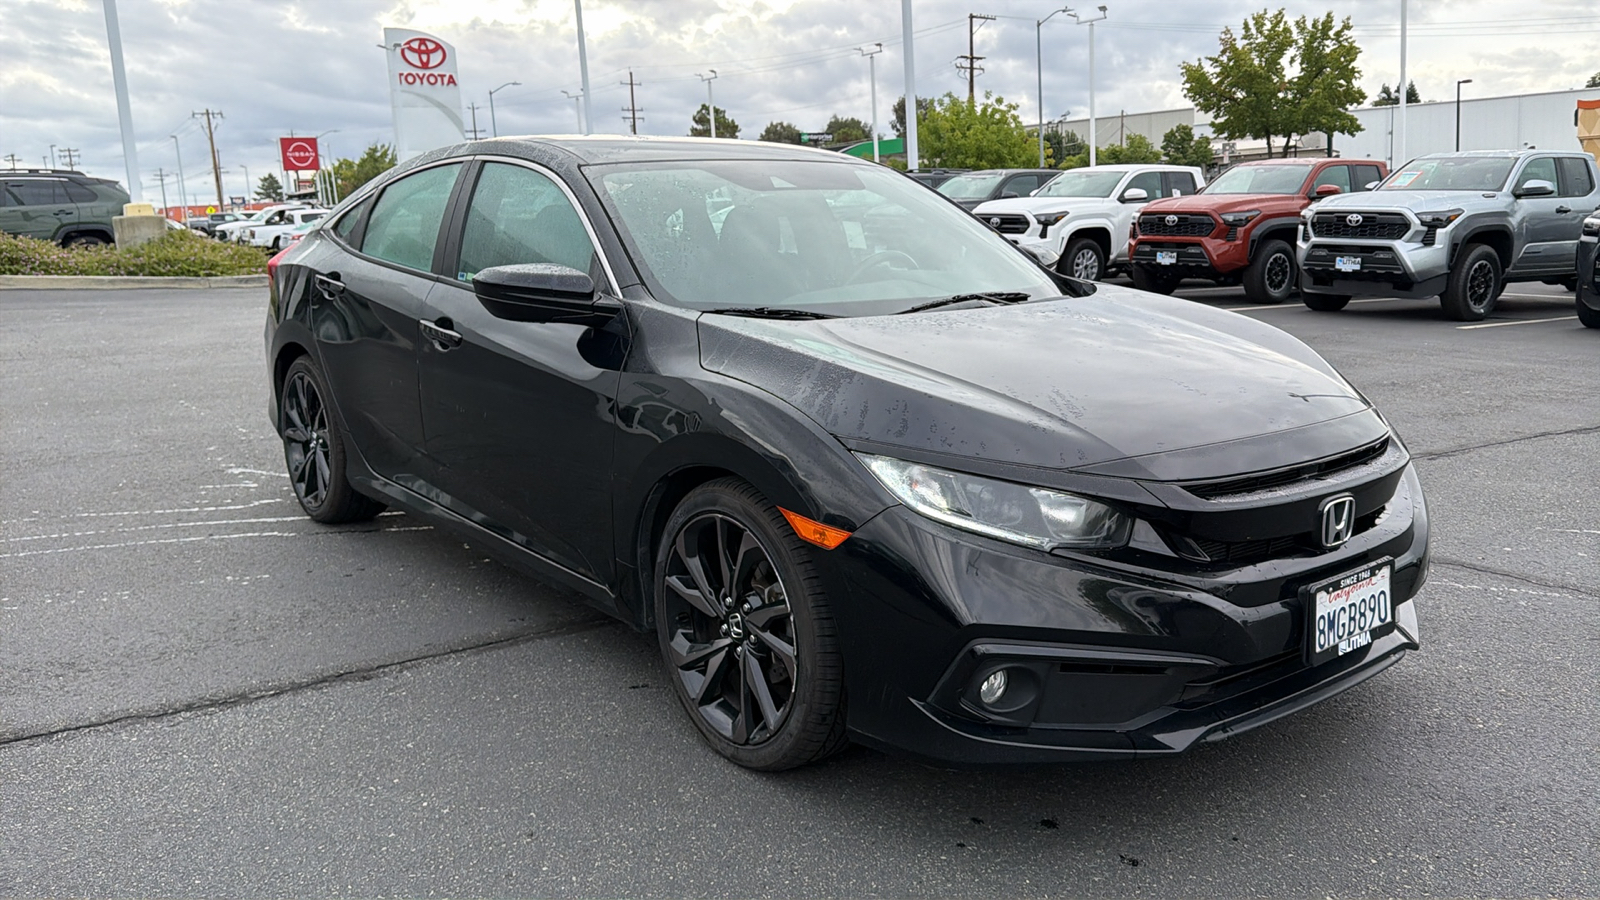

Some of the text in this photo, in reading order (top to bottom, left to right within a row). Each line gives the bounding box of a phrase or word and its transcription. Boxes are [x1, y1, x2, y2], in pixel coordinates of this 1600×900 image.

[398, 73, 458, 87] TOYOTA
[1342, 258, 1360, 266] LITHIA
[1340, 574, 1358, 588] SINCE
[1317, 589, 1388, 650] 8MGB890
[1346, 630, 1372, 653] LITHIA
